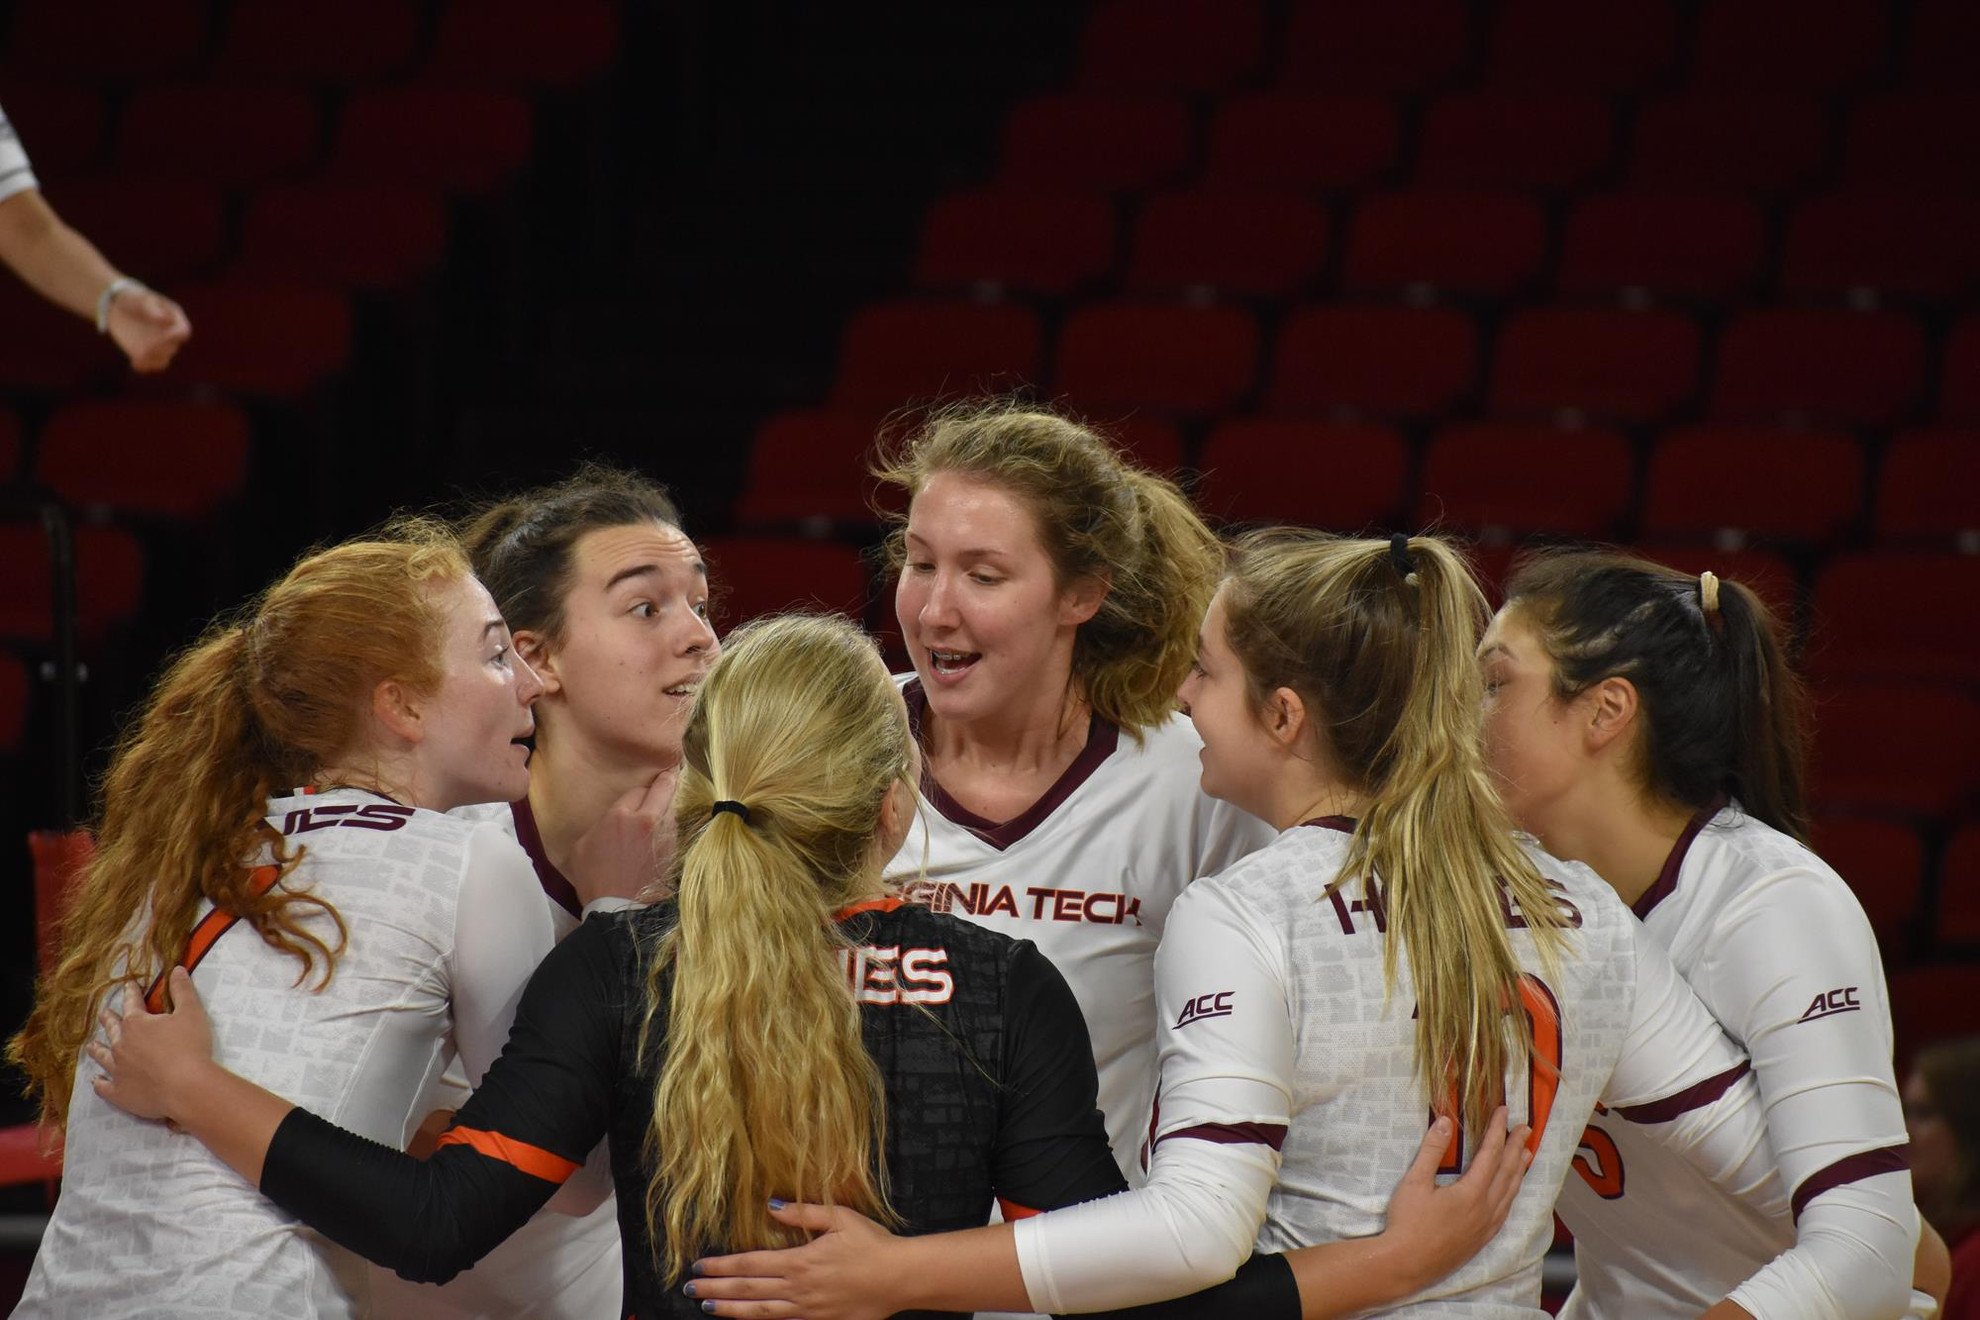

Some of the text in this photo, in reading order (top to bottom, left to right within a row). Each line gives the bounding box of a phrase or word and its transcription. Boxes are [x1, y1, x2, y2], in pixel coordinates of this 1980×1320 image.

[1026, 886, 1142, 926] TECH
[1176, 991, 1236, 1026] ACC
[1801, 987, 1860, 1020] ACC
